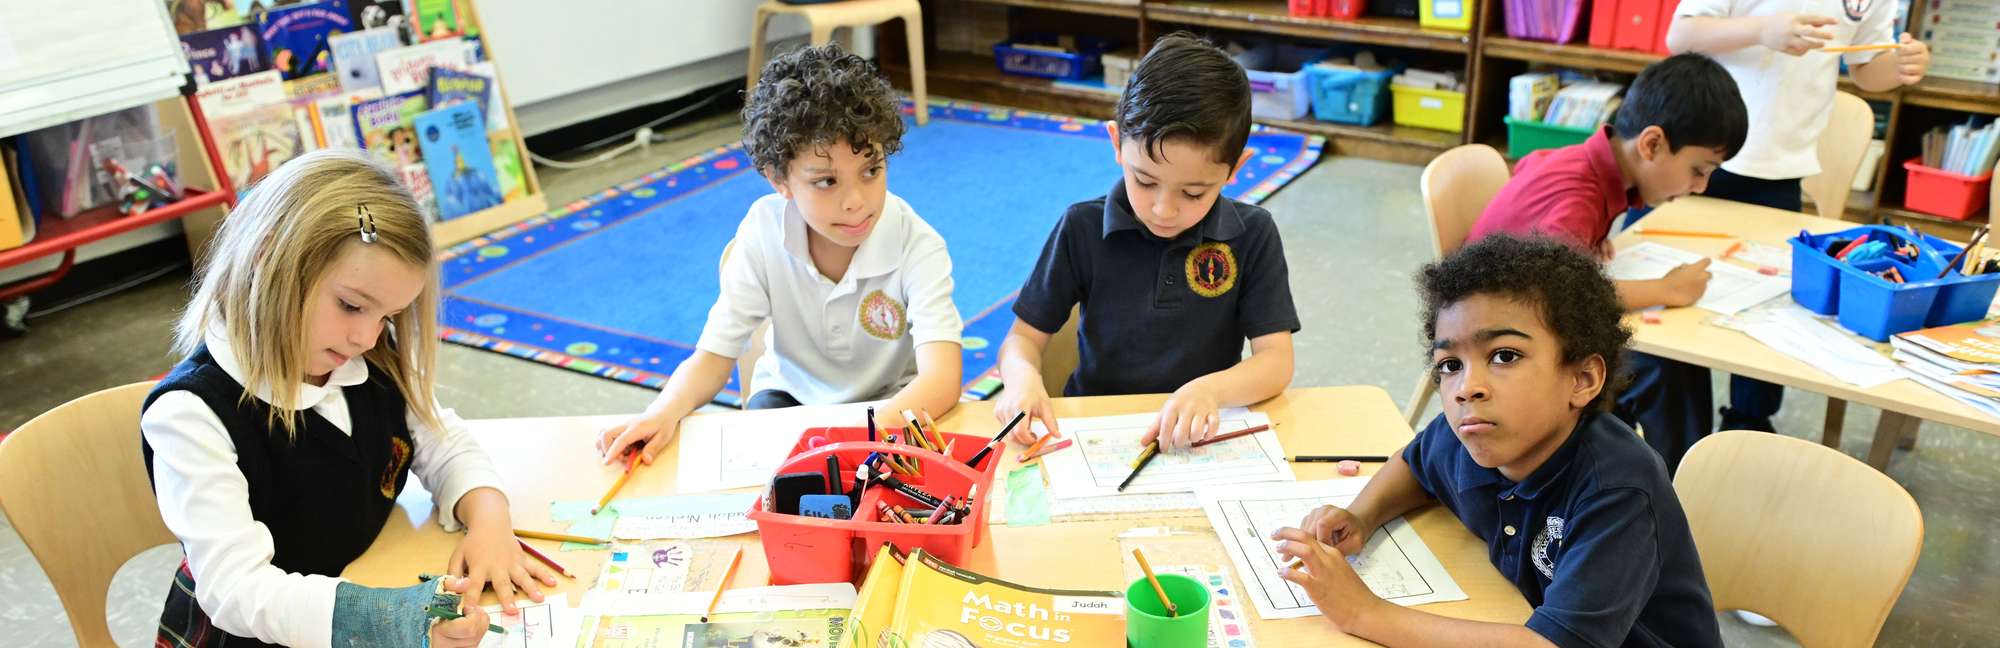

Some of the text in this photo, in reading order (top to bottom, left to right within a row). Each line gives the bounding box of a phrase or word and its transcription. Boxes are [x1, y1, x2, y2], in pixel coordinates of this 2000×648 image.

[962, 590, 1071, 623] Math in
[1071, 600, 1108, 610] Judah
[960, 606, 1071, 644] Focus
